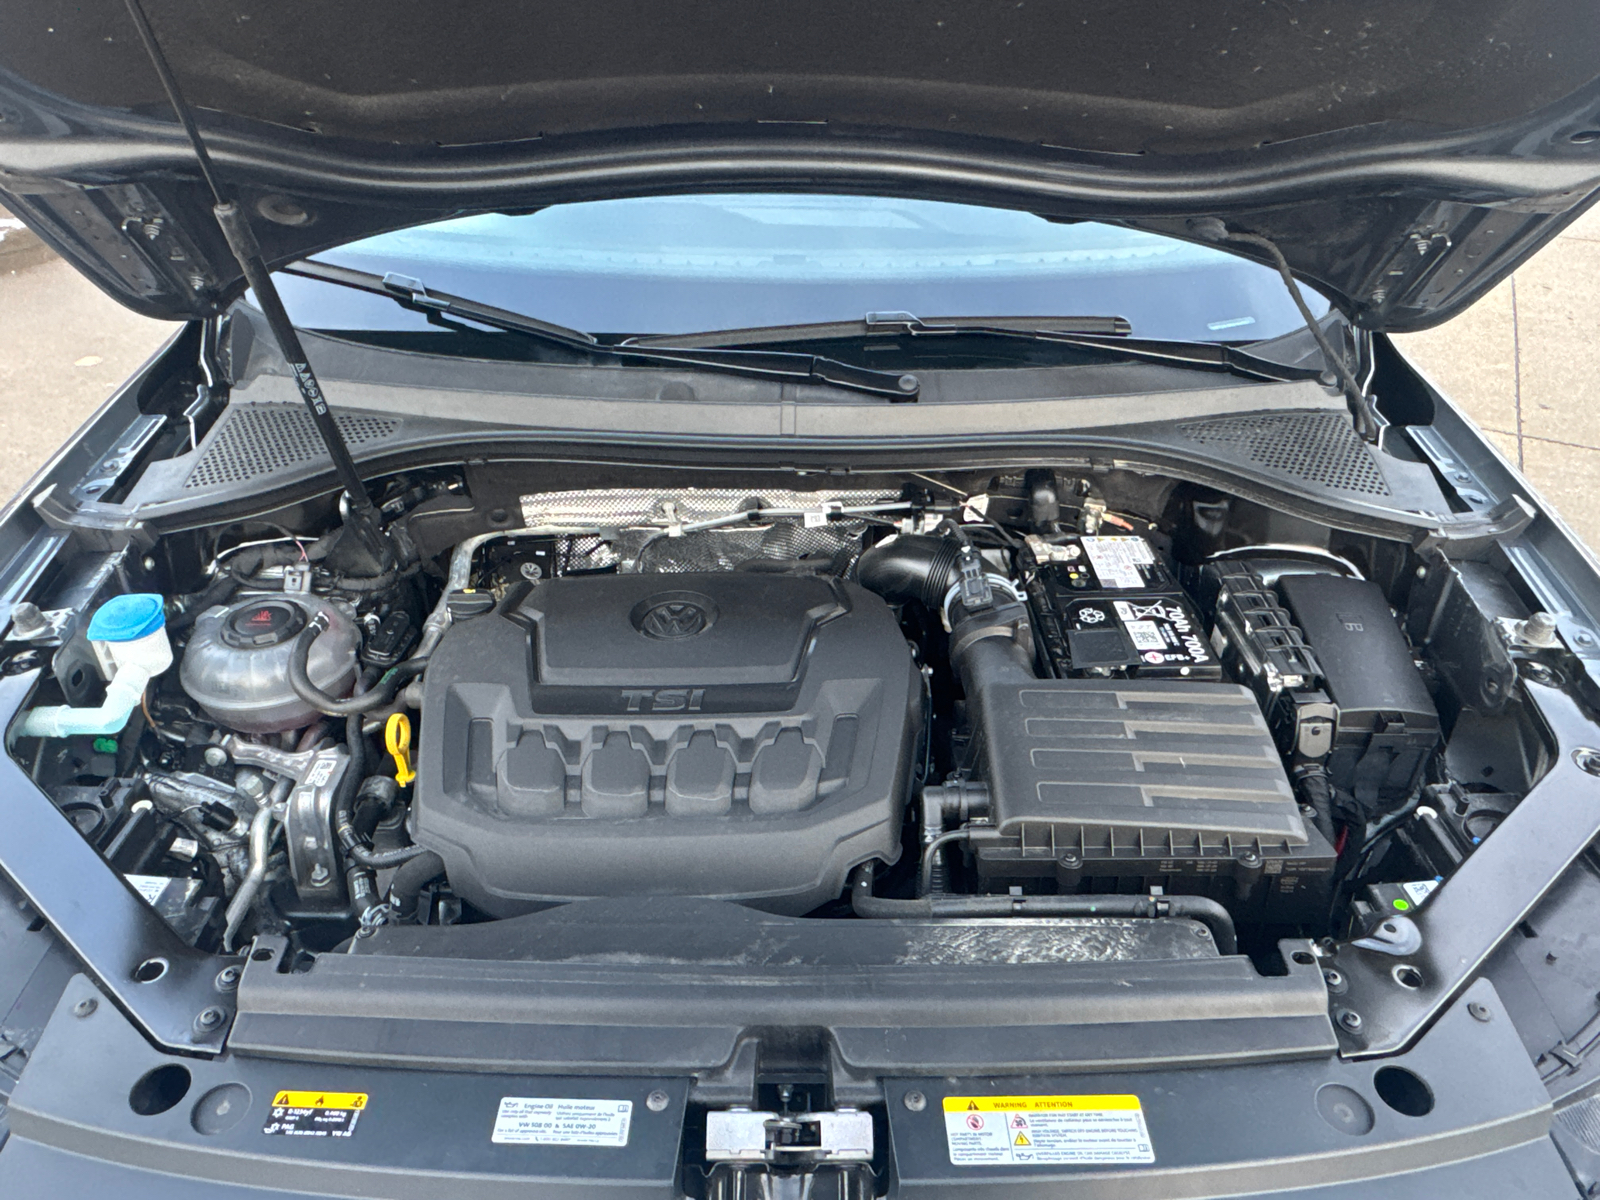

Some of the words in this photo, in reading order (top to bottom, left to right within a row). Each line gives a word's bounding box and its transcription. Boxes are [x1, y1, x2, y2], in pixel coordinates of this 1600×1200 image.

[1165, 606, 1191, 632] 70Ah
[1181, 634, 1209, 663] 700A
[621, 688, 706, 711] TSI
